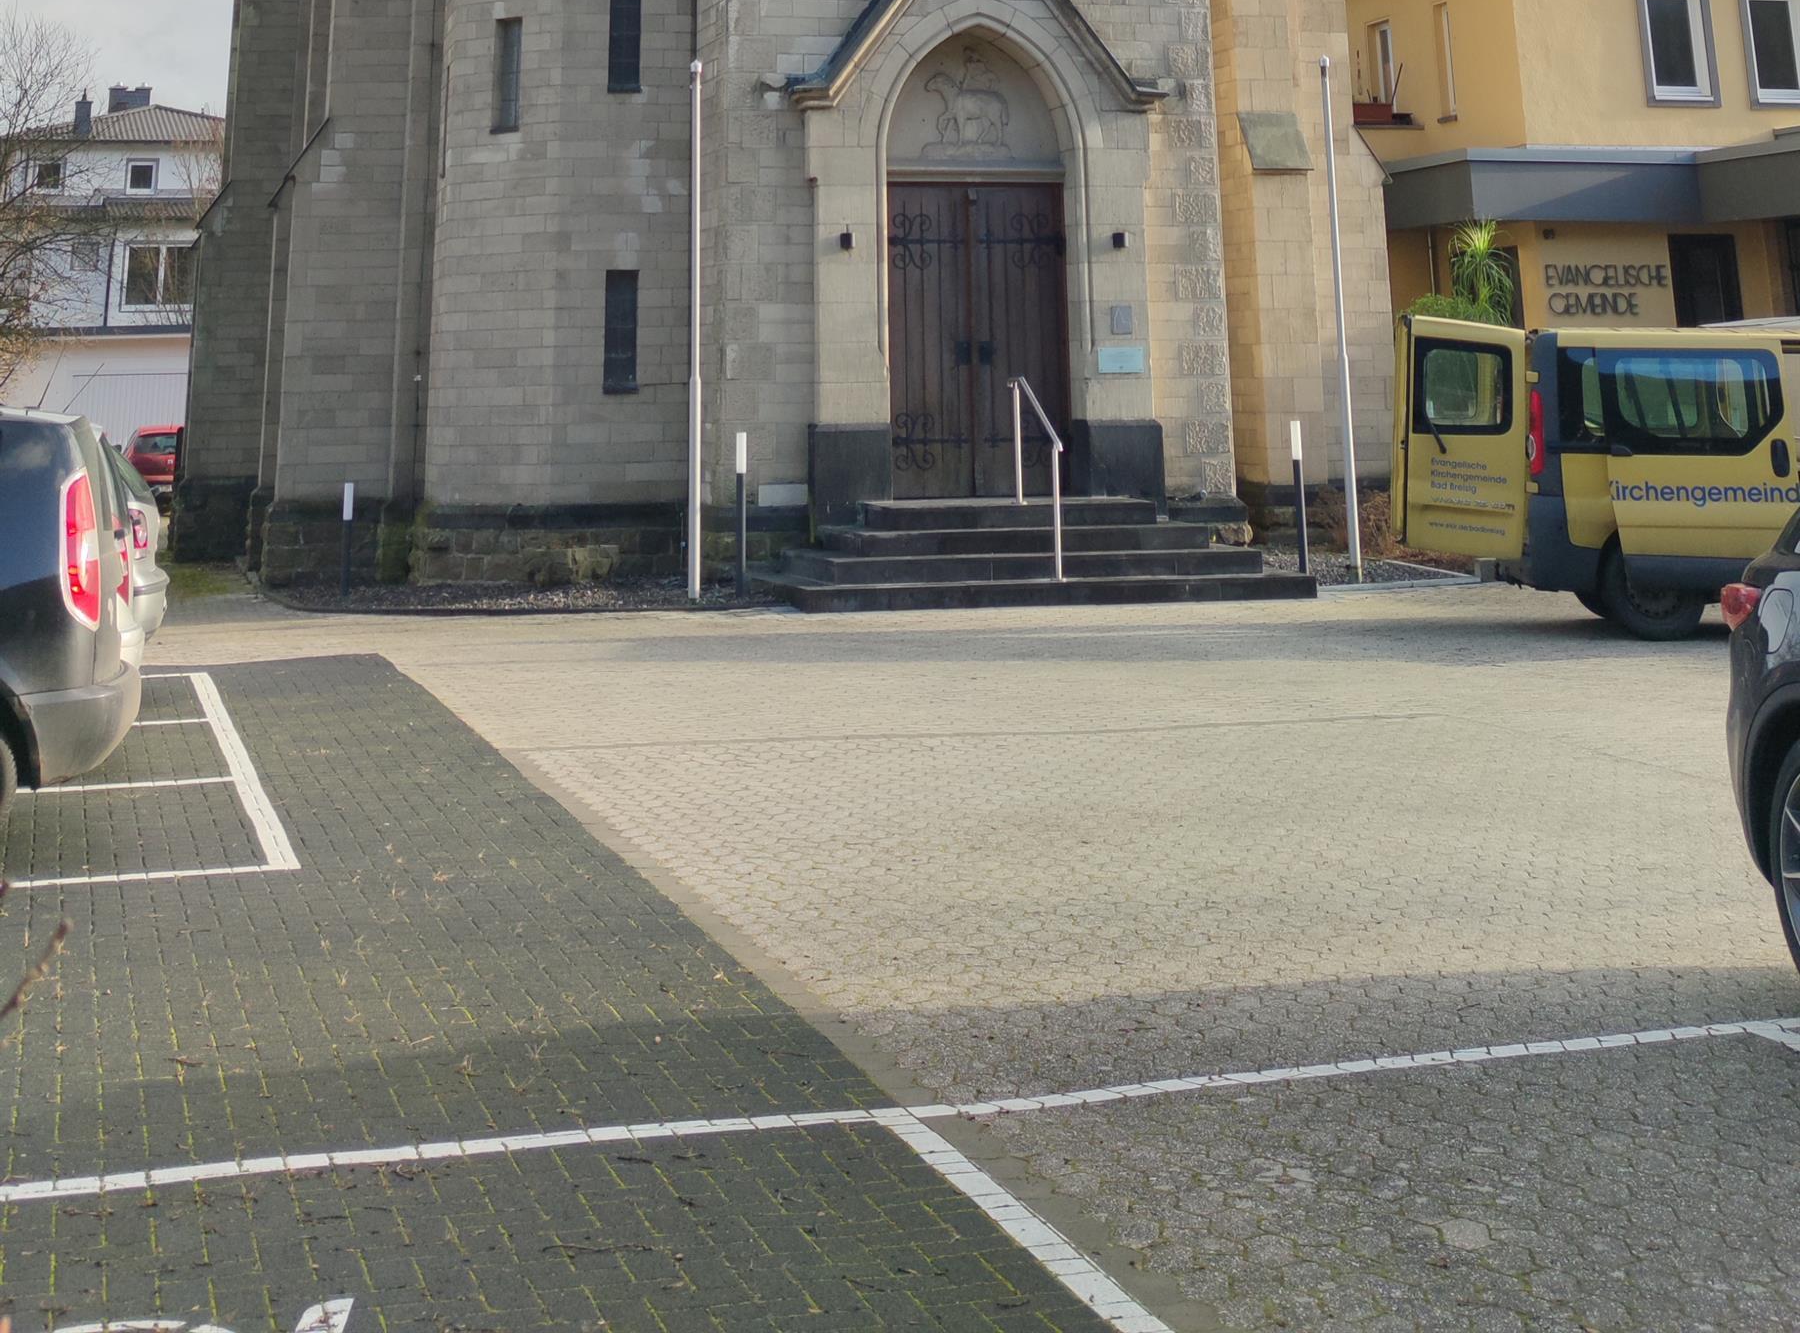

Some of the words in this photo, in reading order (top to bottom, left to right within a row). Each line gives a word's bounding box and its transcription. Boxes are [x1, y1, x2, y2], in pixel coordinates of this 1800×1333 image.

[1544, 263, 1668, 287] EVANGELISCHE
[1548, 292, 1639, 316] GEMEINDE
[1431, 457, 1487, 471] Evangelische
[1431, 469, 1508, 485] Kirchengemeinde
[1431, 480, 1447, 490] Bad
[1450, 482, 1477, 494] Breisig
